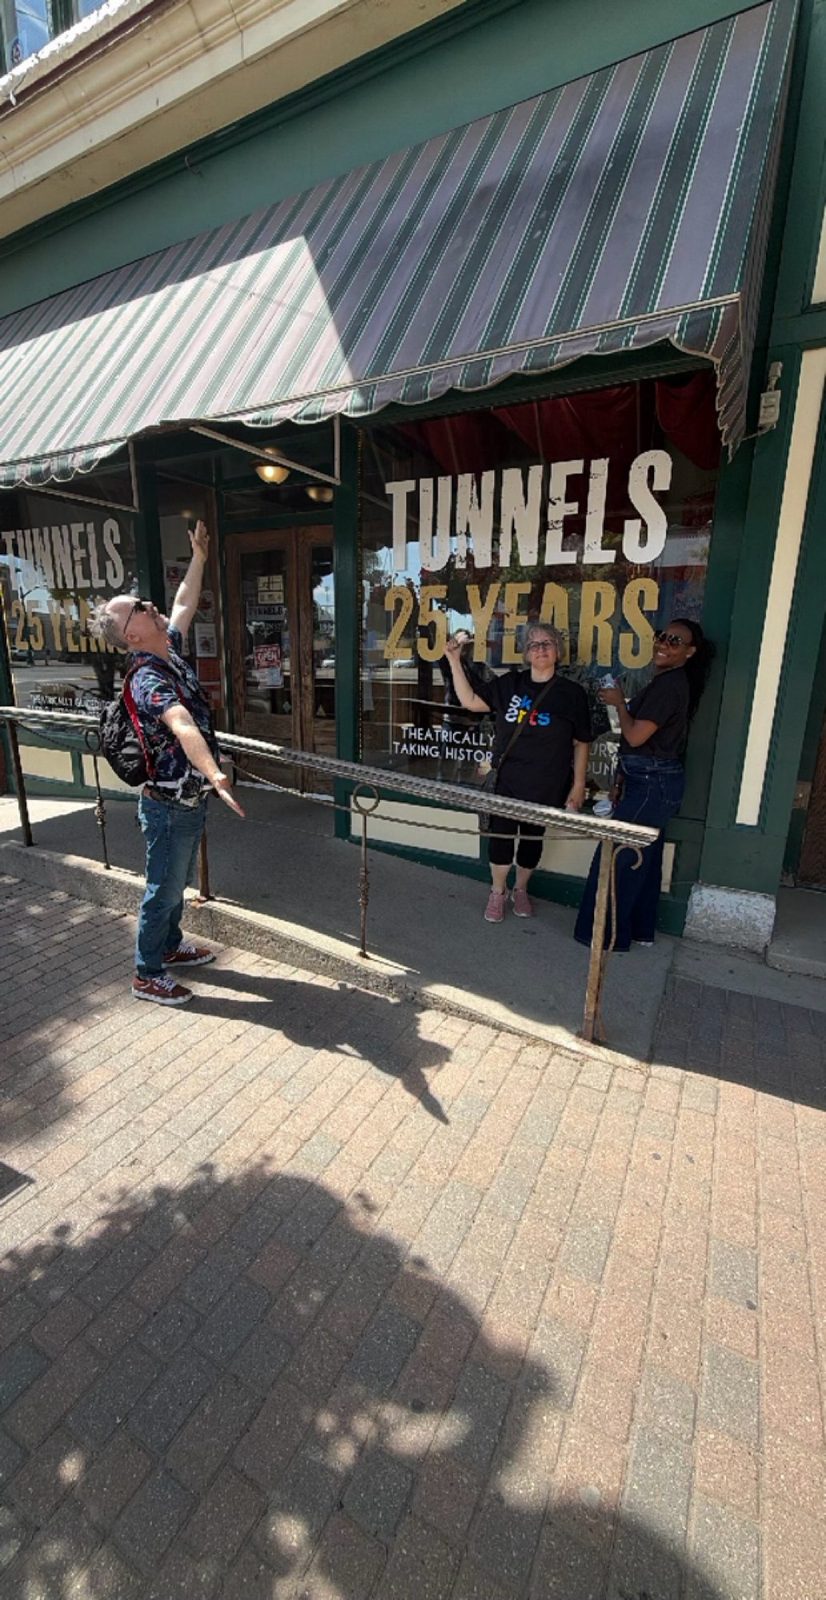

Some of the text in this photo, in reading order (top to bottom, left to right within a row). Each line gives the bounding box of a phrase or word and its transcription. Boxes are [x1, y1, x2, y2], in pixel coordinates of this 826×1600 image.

[385, 449, 672, 572] TUNNELS
[1, 518, 125, 591] TUNNELS
[11, 597, 127, 654] 25 YEA
[384, 578, 660, 669] 25 YEARS
[393, 741, 493, 763] TAKING HISTOR
[400, 725, 495, 747] THEATRICALLY
